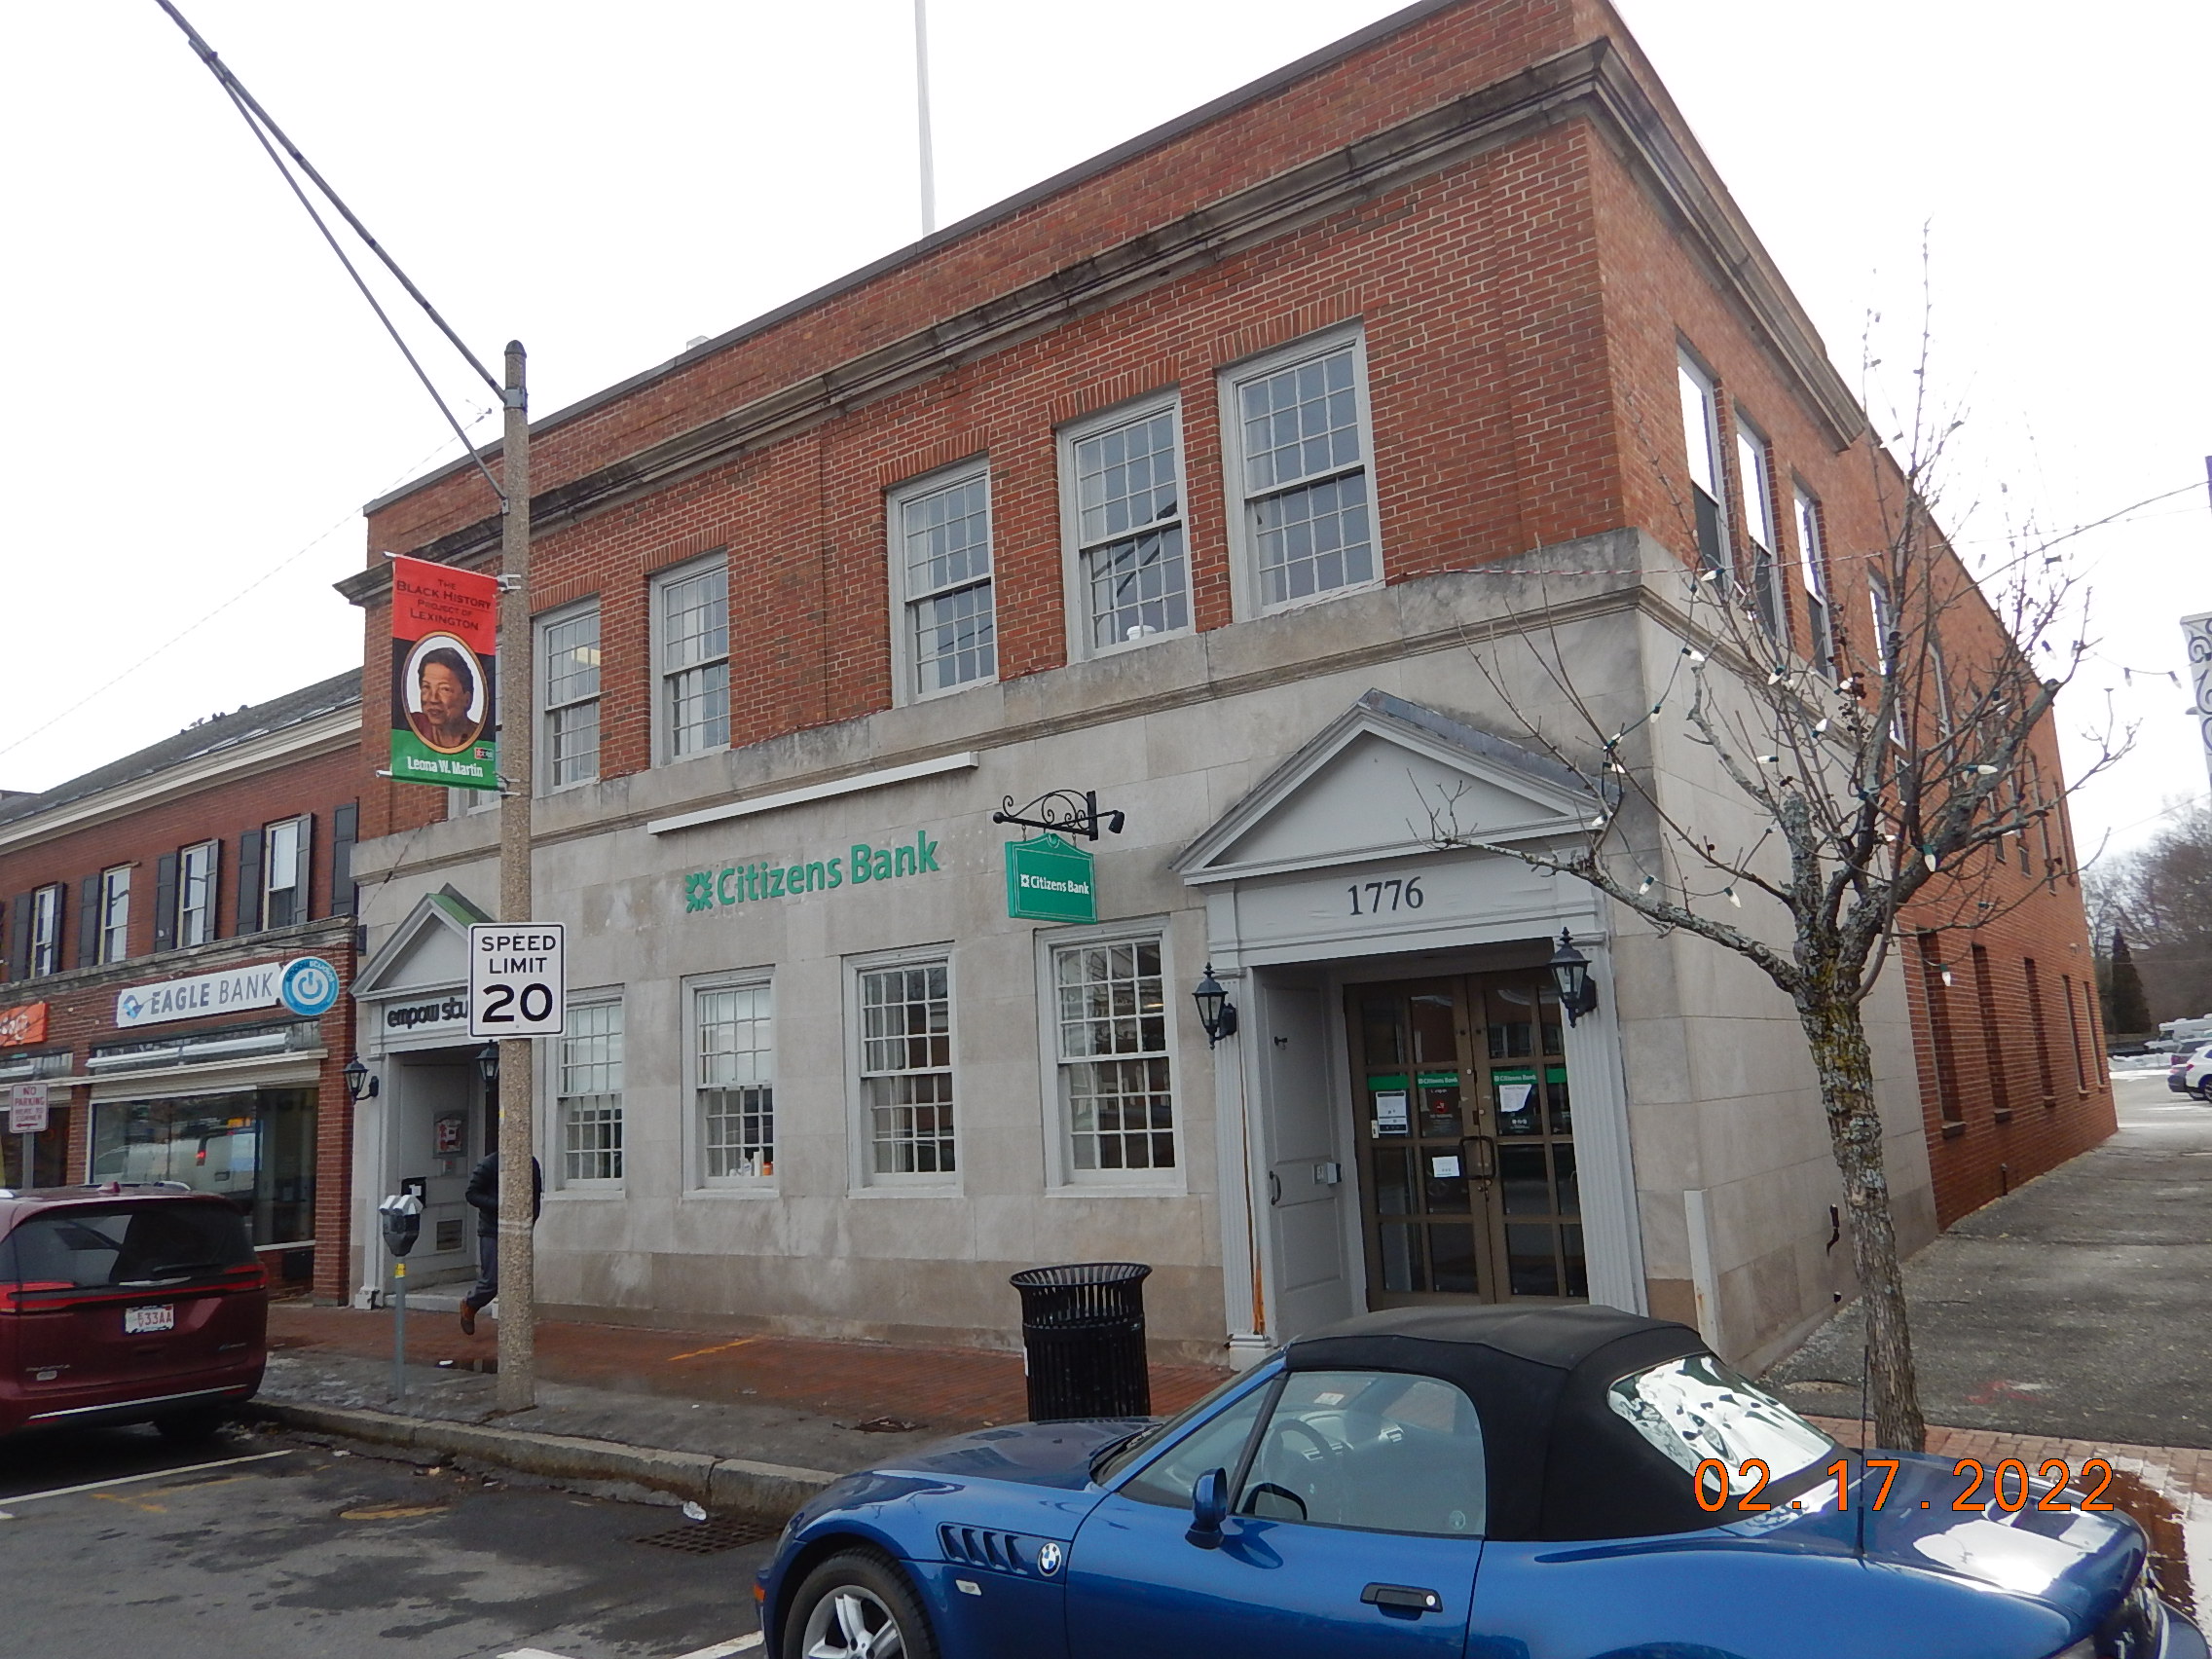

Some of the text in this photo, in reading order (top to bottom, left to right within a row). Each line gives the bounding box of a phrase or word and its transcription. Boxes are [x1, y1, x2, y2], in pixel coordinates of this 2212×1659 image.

[396, 580, 492, 610] BLACK HISTORY
[417, 599, 461, 614] PROJECT
[410, 607, 479, 631] LEXINGTON
[407, 756, 438, 773] Leona
[452, 762, 484, 778] Martin
[717, 830, 940, 906] Citizens Bank
[1030, 875, 1089, 895] Citizens Bank
[1347, 876, 1423, 915] 1776
[481, 935, 556, 952] SPEED
[489, 957, 547, 975] LIMIT
[150, 973, 274, 1015] EAGLE BANK
[482, 983, 553, 1023] 20
[15, 1096, 45, 1106] PARKING
[22, 1086, 36, 1095] NO
